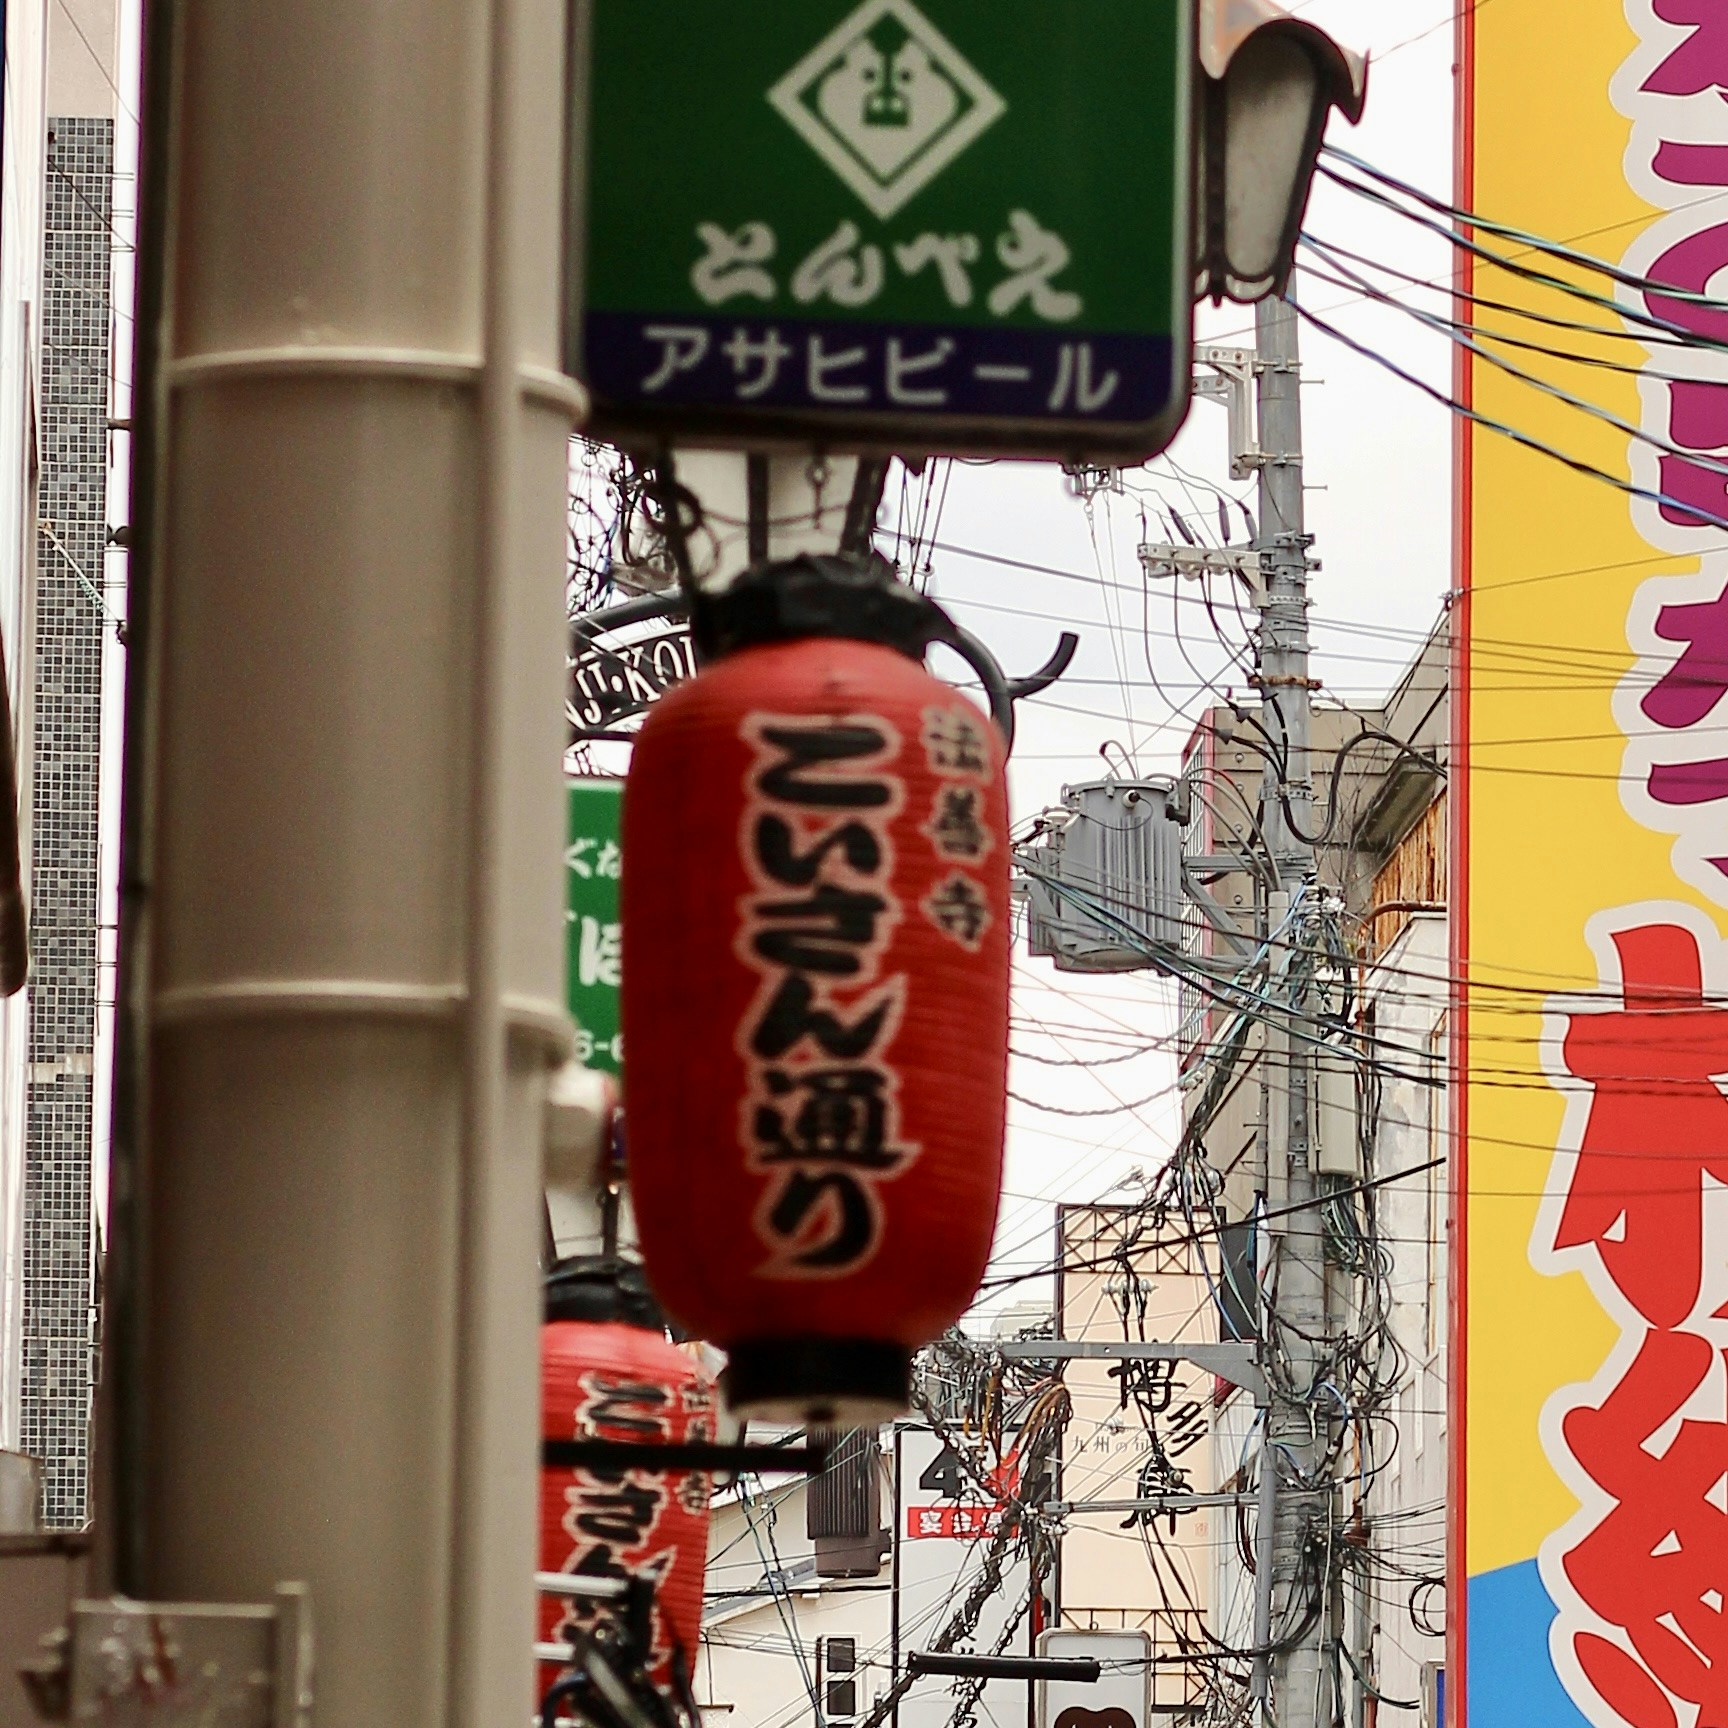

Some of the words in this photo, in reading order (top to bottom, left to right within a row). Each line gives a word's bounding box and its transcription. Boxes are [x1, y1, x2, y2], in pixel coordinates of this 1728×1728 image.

[689, 208, 1082, 322] とんべえ
[640, 324, 1118, 412] アサヒビール
[748, 718, 912, 1270] こいさん通り
